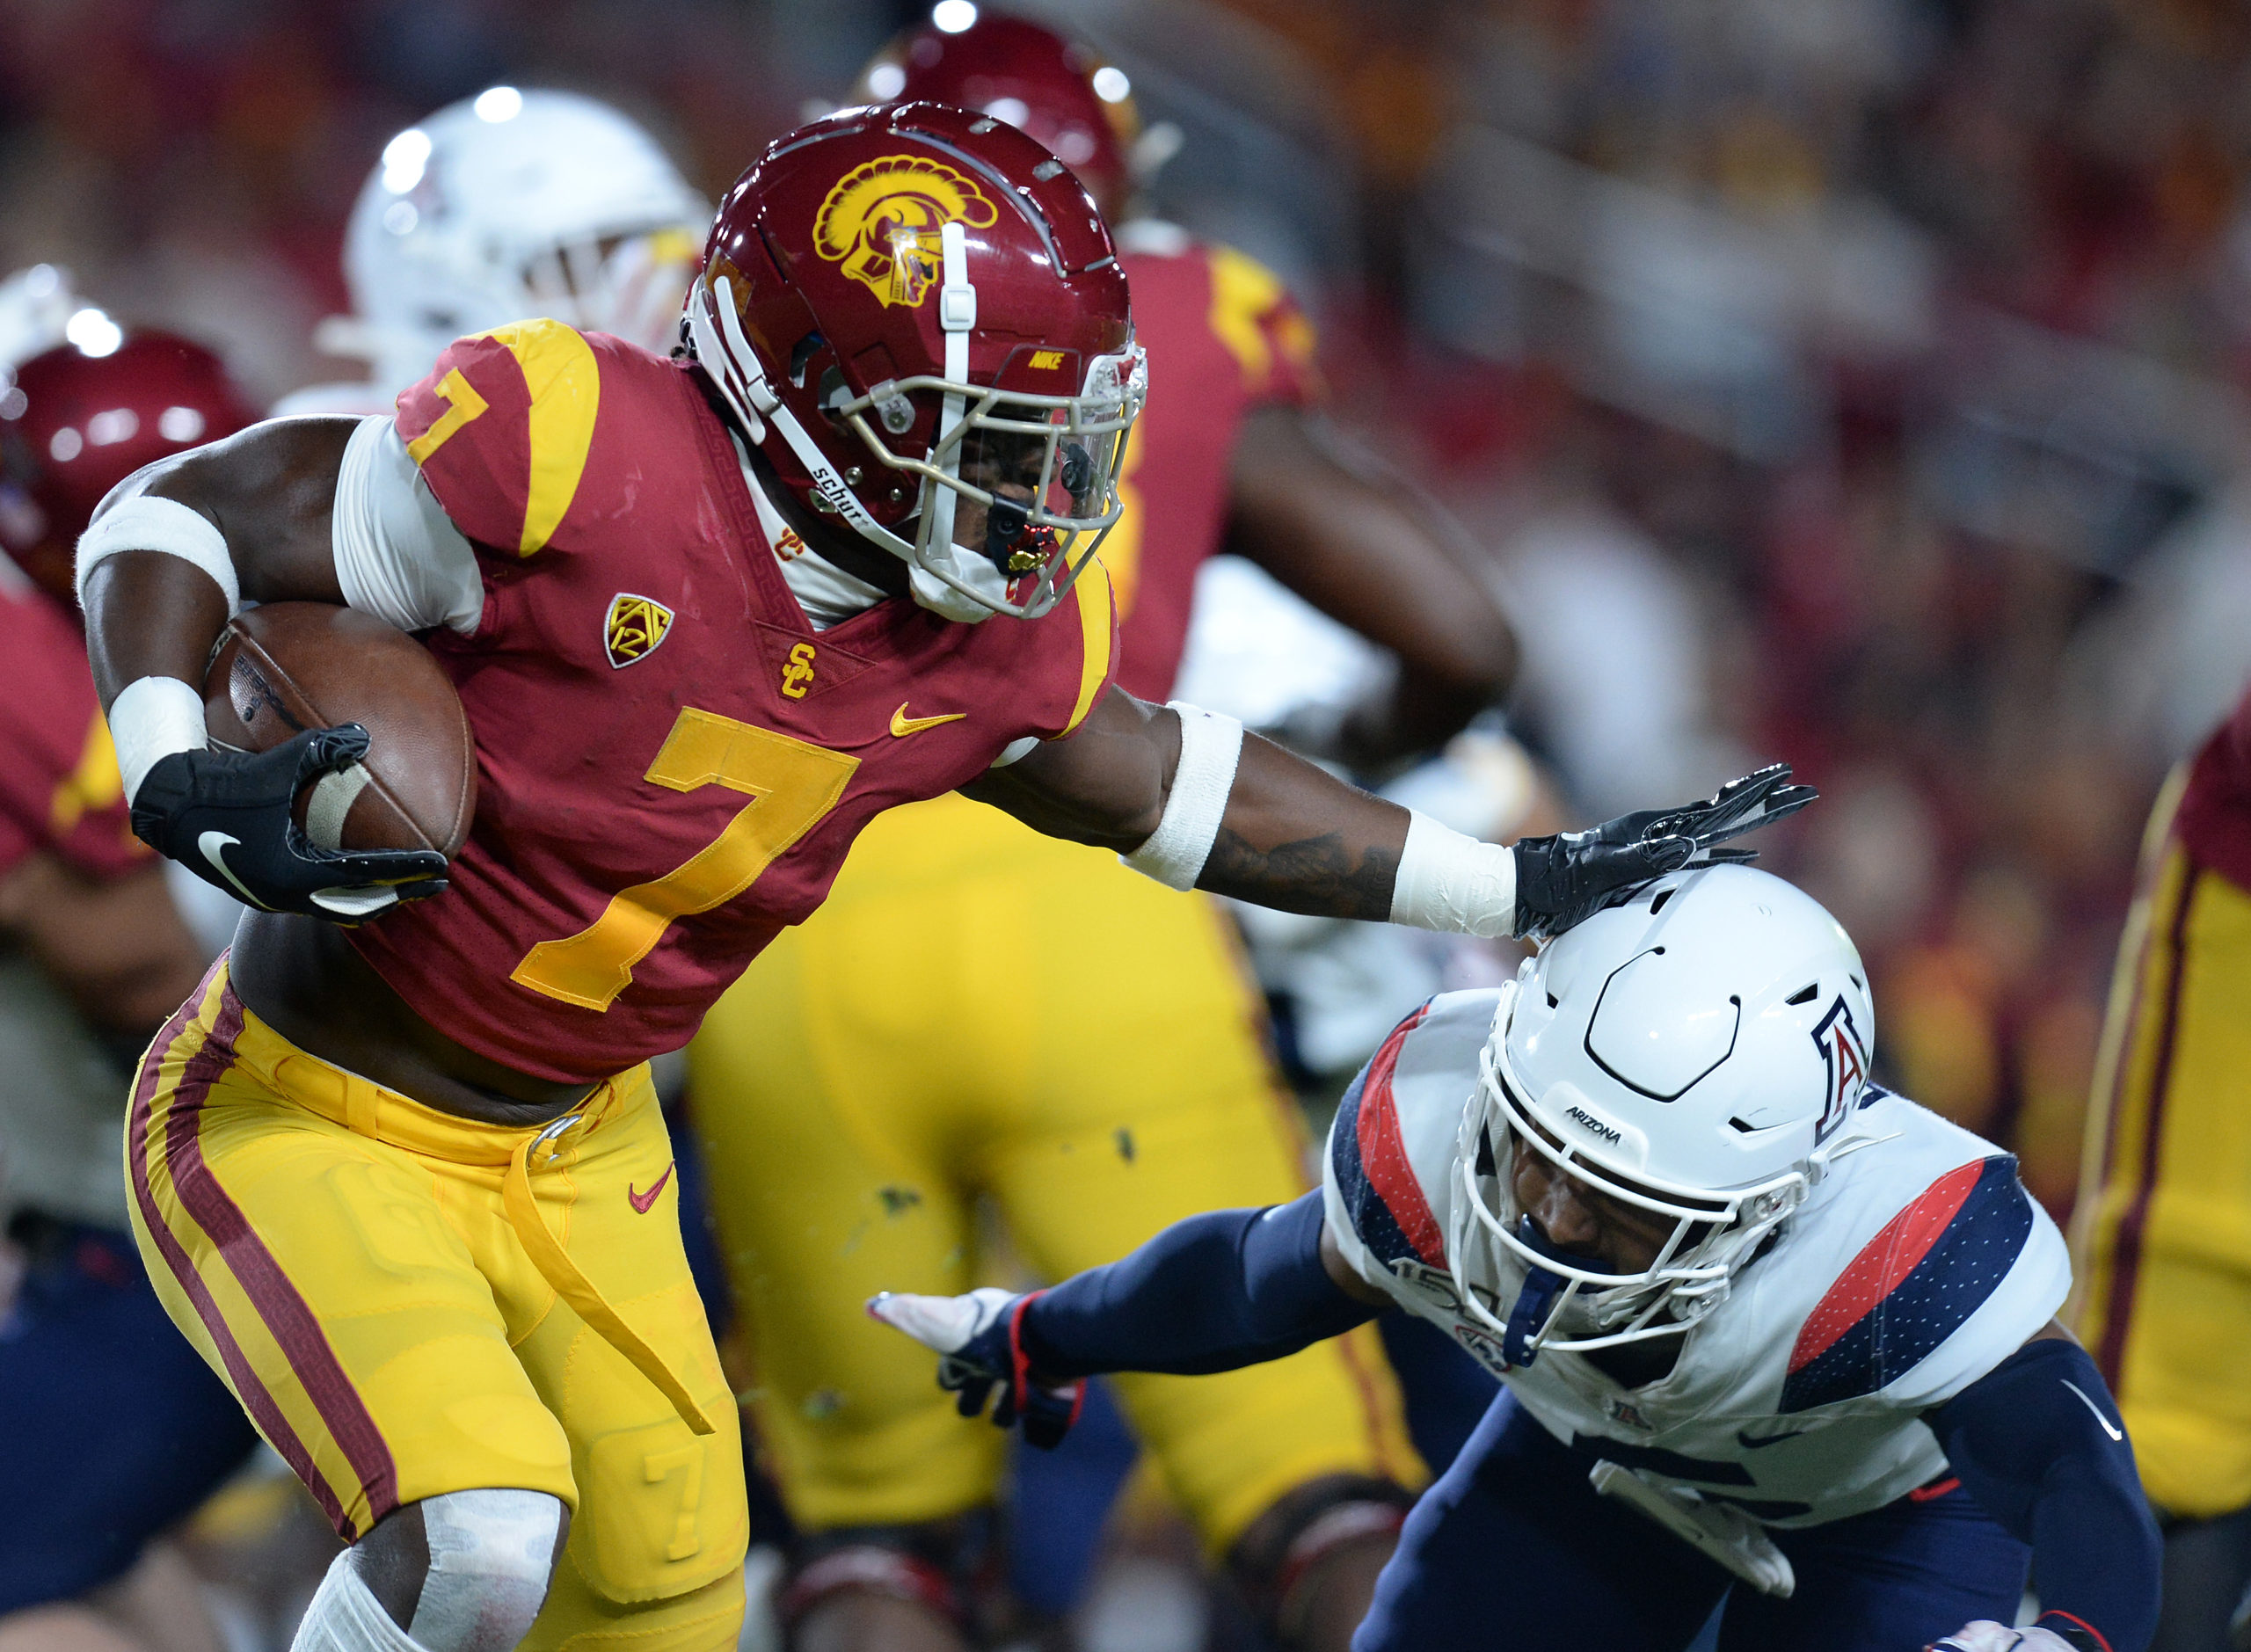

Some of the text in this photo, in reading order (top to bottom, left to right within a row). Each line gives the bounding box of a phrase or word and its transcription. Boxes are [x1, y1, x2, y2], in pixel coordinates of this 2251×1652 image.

[1027, 351, 1065, 370] NIKE
[406, 367, 489, 467] 7
[609, 597, 670, 648] PAC
[610, 626, 646, 658] 12
[782, 642, 816, 699] SC
[509, 706, 863, 1012] 7
[1810, 993, 1870, 1148] A
[1565, 1106, 1621, 1144] ARIZONA
[643, 1443, 703, 1563] 7
